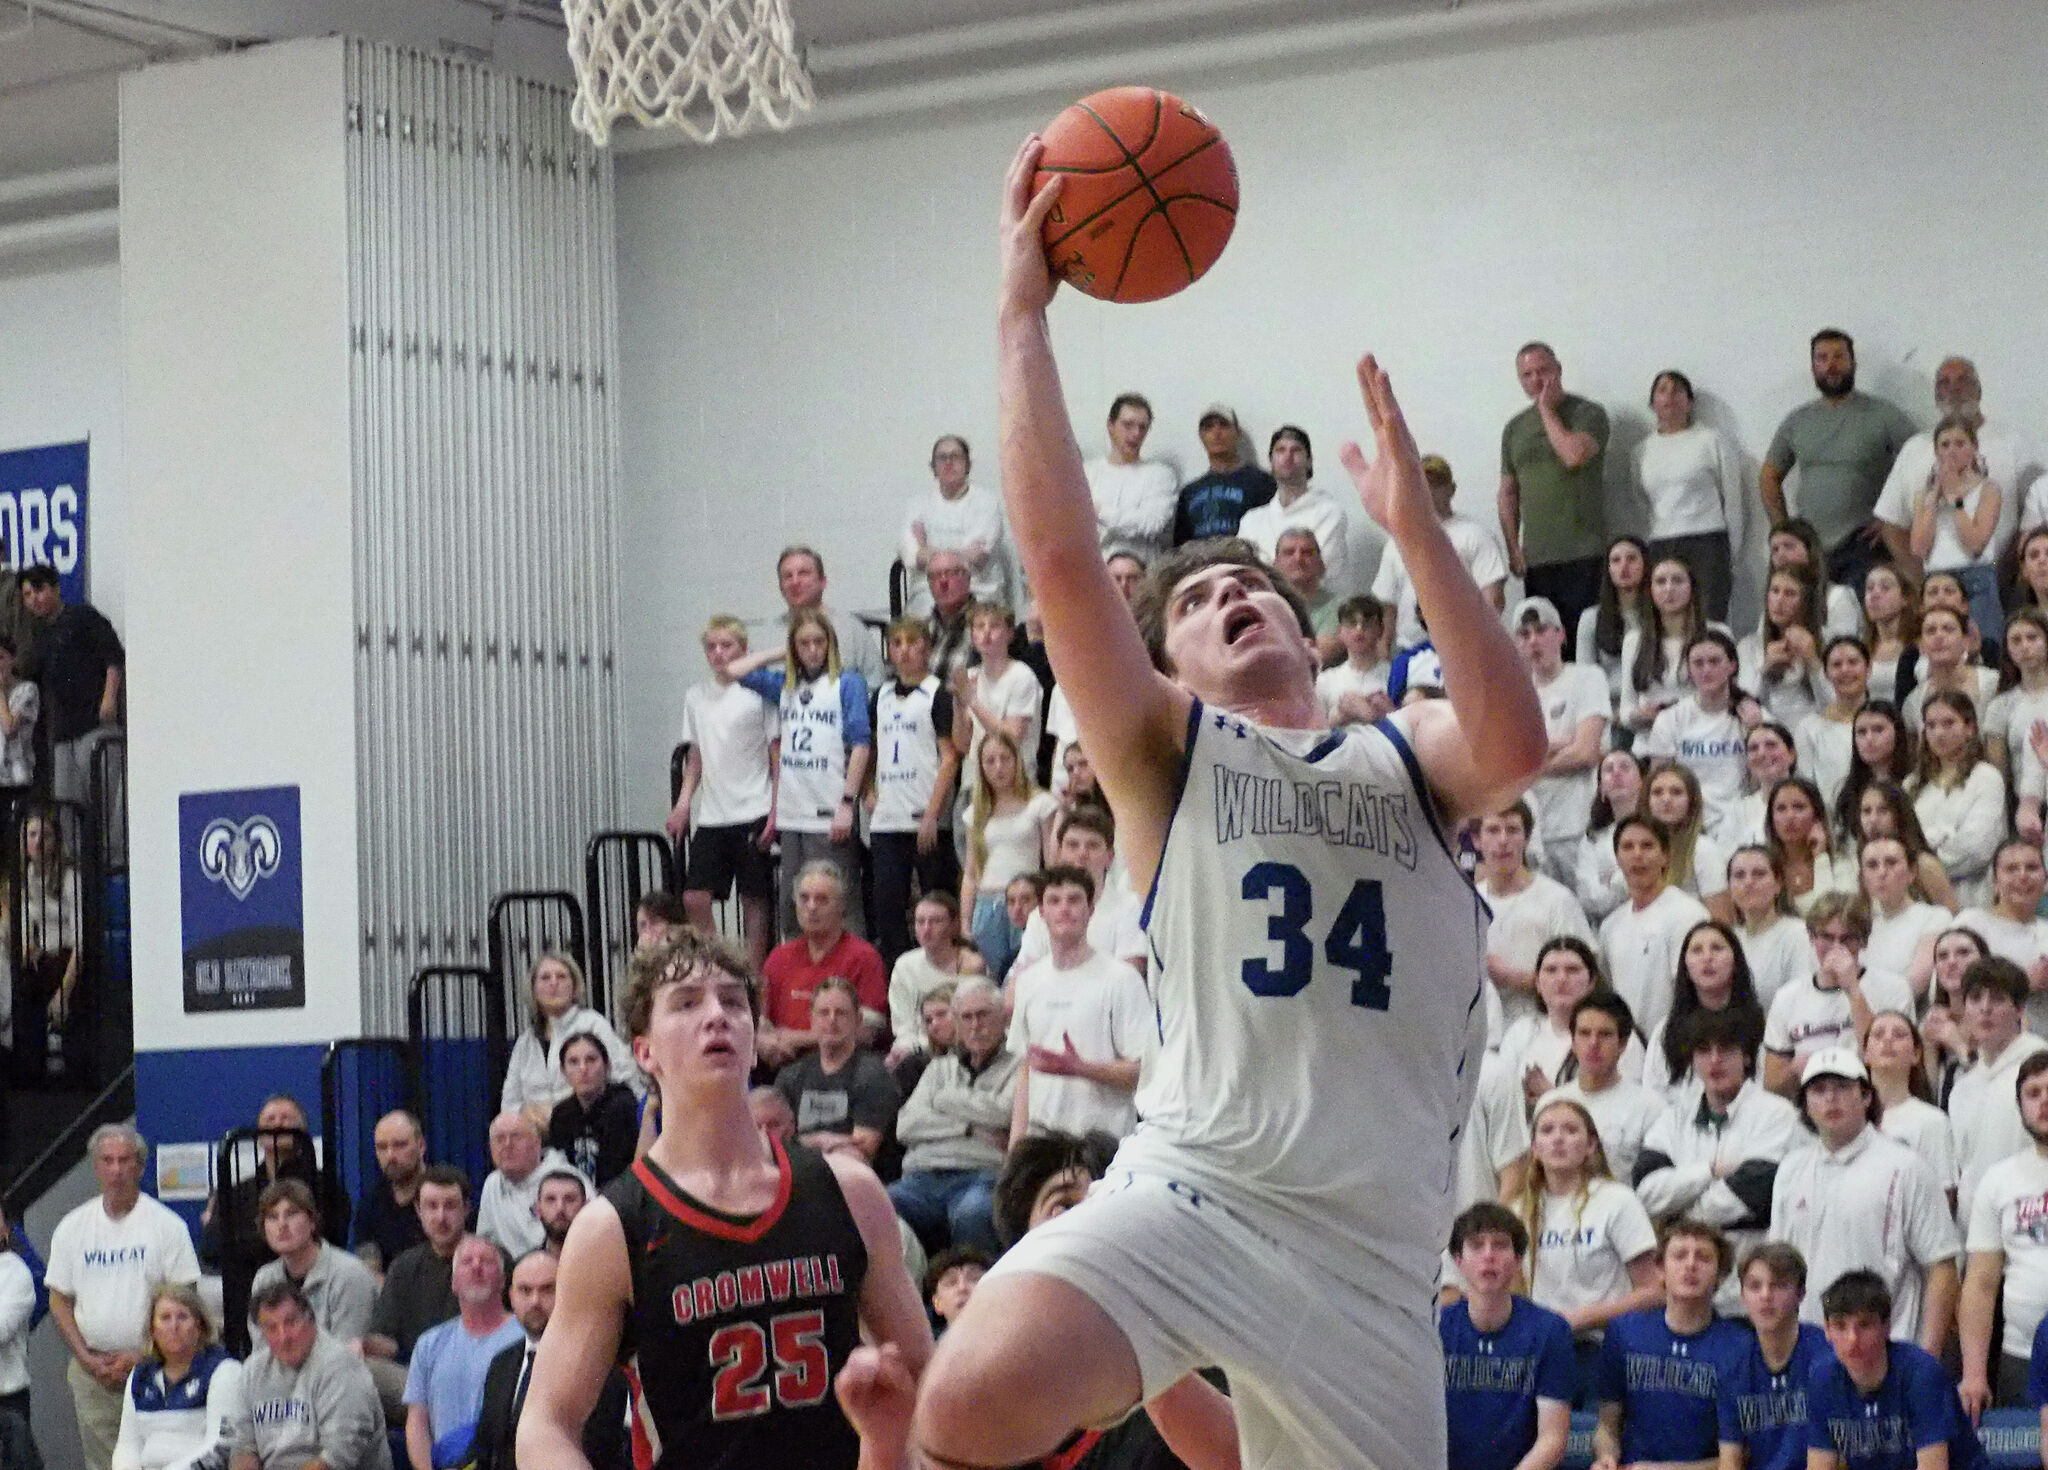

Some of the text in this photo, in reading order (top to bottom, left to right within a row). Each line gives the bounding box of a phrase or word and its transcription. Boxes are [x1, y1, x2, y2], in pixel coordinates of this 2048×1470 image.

[792, 727, 812, 752] 12
[892, 739, 899, 764] 1
[1682, 739, 1745, 756] WILDCA
[1213, 764, 1418, 872] WILDCATS
[1242, 861, 1393, 1011] 34
[672, 1253, 845, 1326] CROMWELL
[709, 1308, 830, 1422] 25
